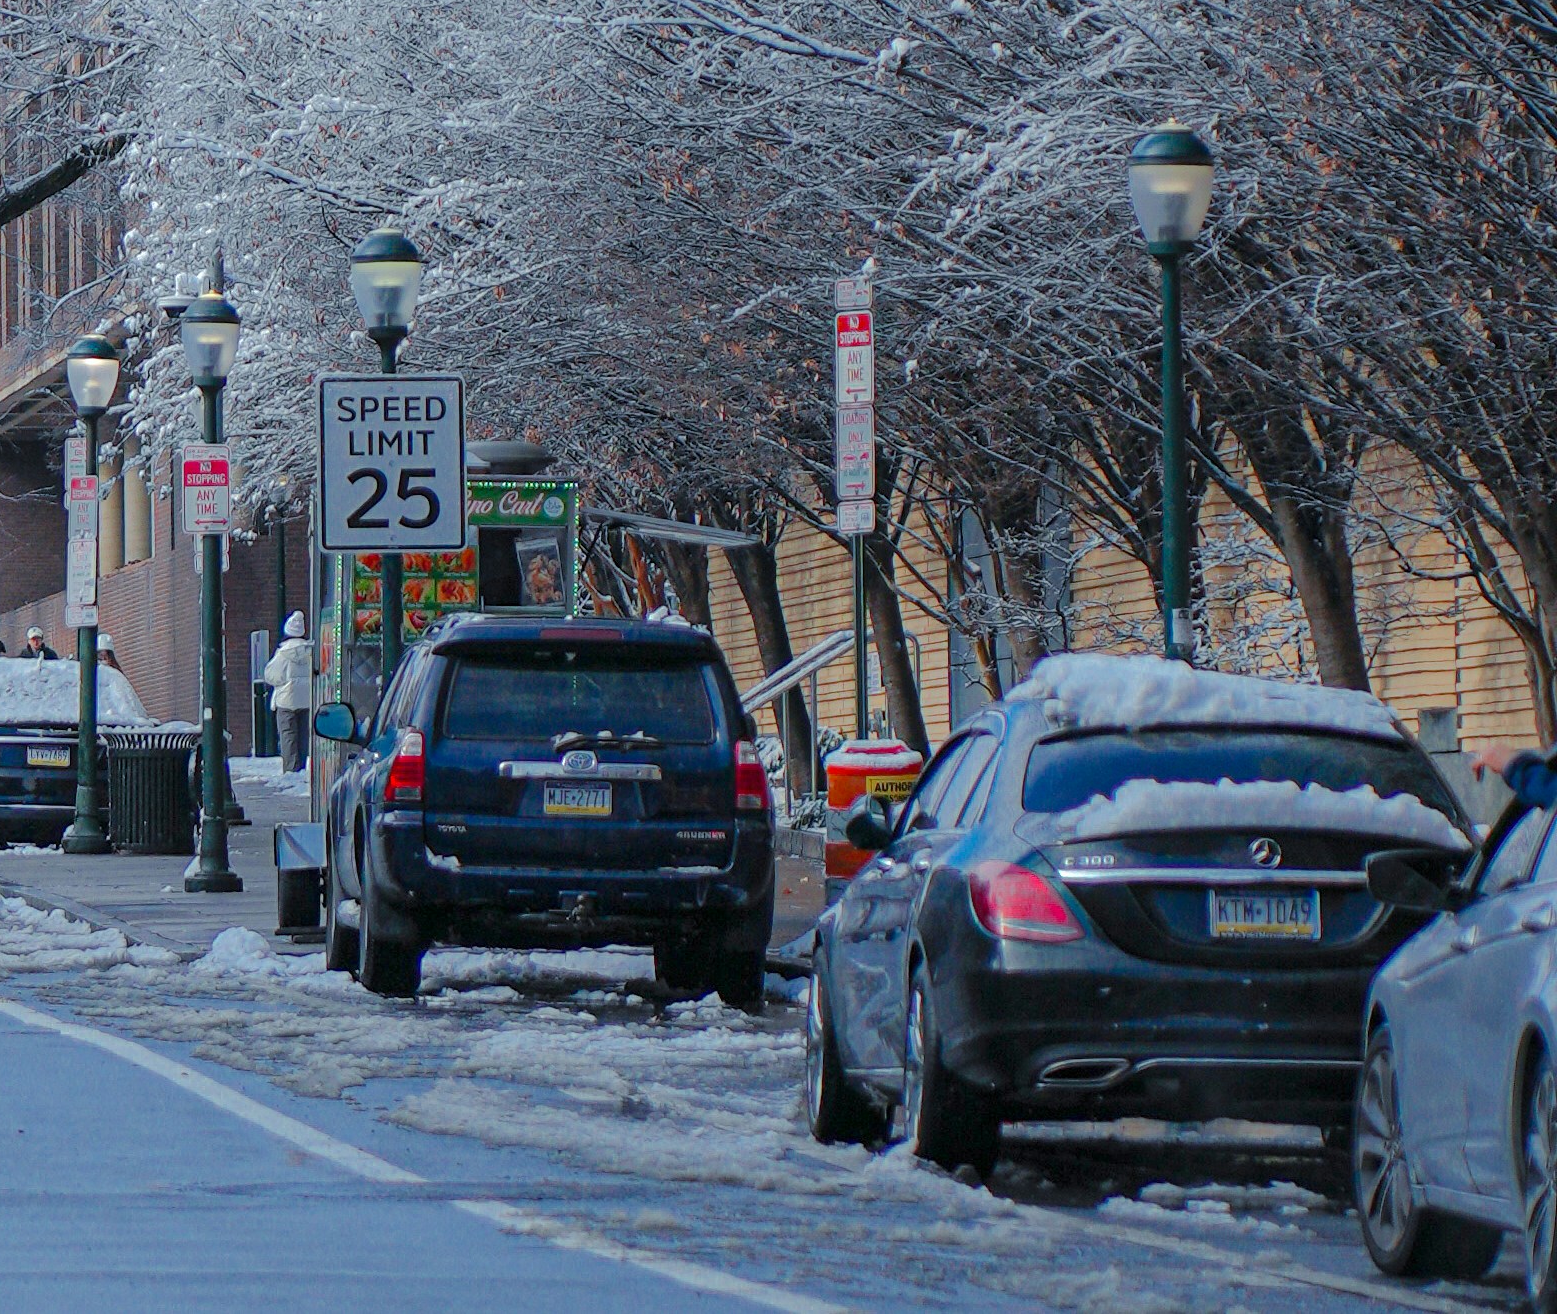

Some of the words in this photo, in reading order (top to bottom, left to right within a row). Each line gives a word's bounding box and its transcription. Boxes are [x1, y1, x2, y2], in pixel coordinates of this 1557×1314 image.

[839, 331, 870, 344] STOPPING
[847, 350, 863, 365] ANY
[847, 367, 864, 382] TIME
[337, 396, 447, 422] SPEED
[842, 413, 869, 426] LOADING
[349, 430, 435, 456] LIMIT
[848, 431, 864, 443] ONLY
[199, 461, 212, 472] NO
[186, 473, 226, 484] STOPPING
[196, 489, 217, 501] ANY
[346, 467, 441, 529] 25
[196, 503, 219, 515] TIME
[498, 490, 545, 515] Cart
